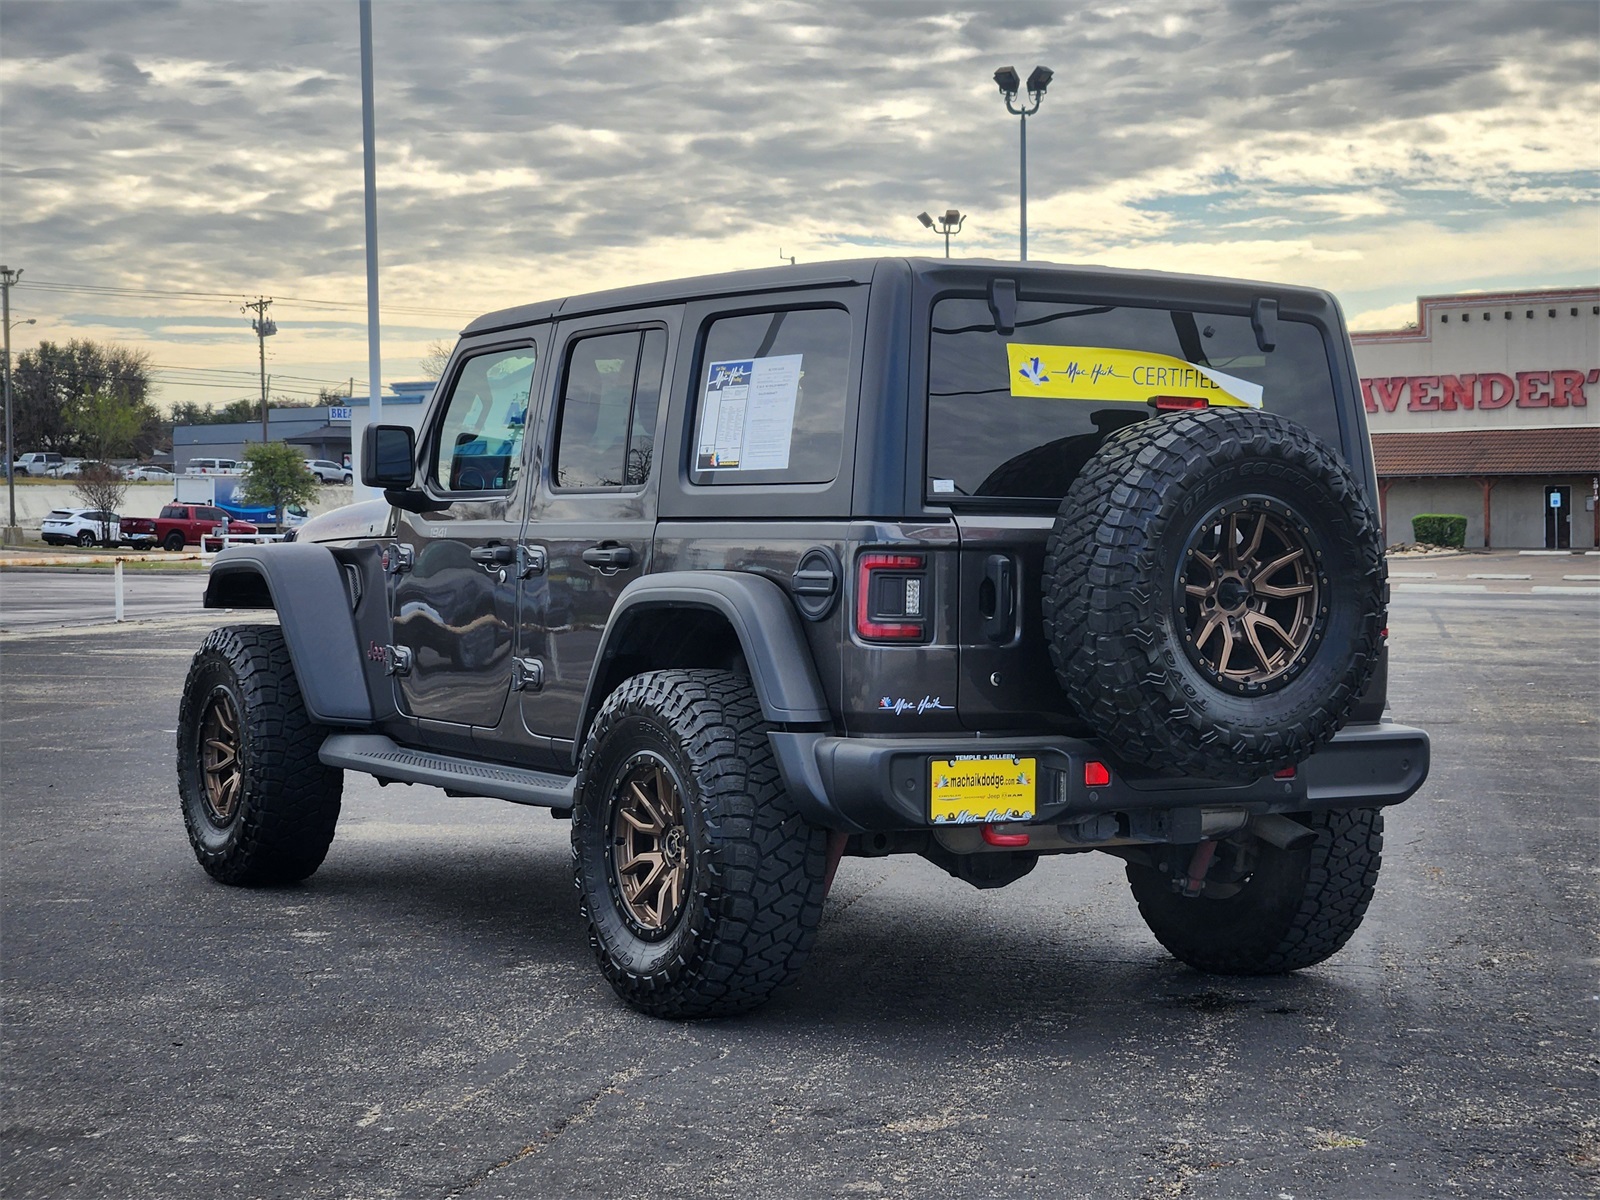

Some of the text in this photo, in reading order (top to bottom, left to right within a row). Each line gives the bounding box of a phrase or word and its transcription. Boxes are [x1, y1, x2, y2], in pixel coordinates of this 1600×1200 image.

[1051, 361, 1089, 383] Mac
[1090, 363, 1130, 385] Haik
[429, 527, 448, 538] 1941
[878, 695, 955, 716] Mac Haik
[950, 772, 1016, 789] machaikdodge.com
[934, 808, 1031, 824] Mac Haik
